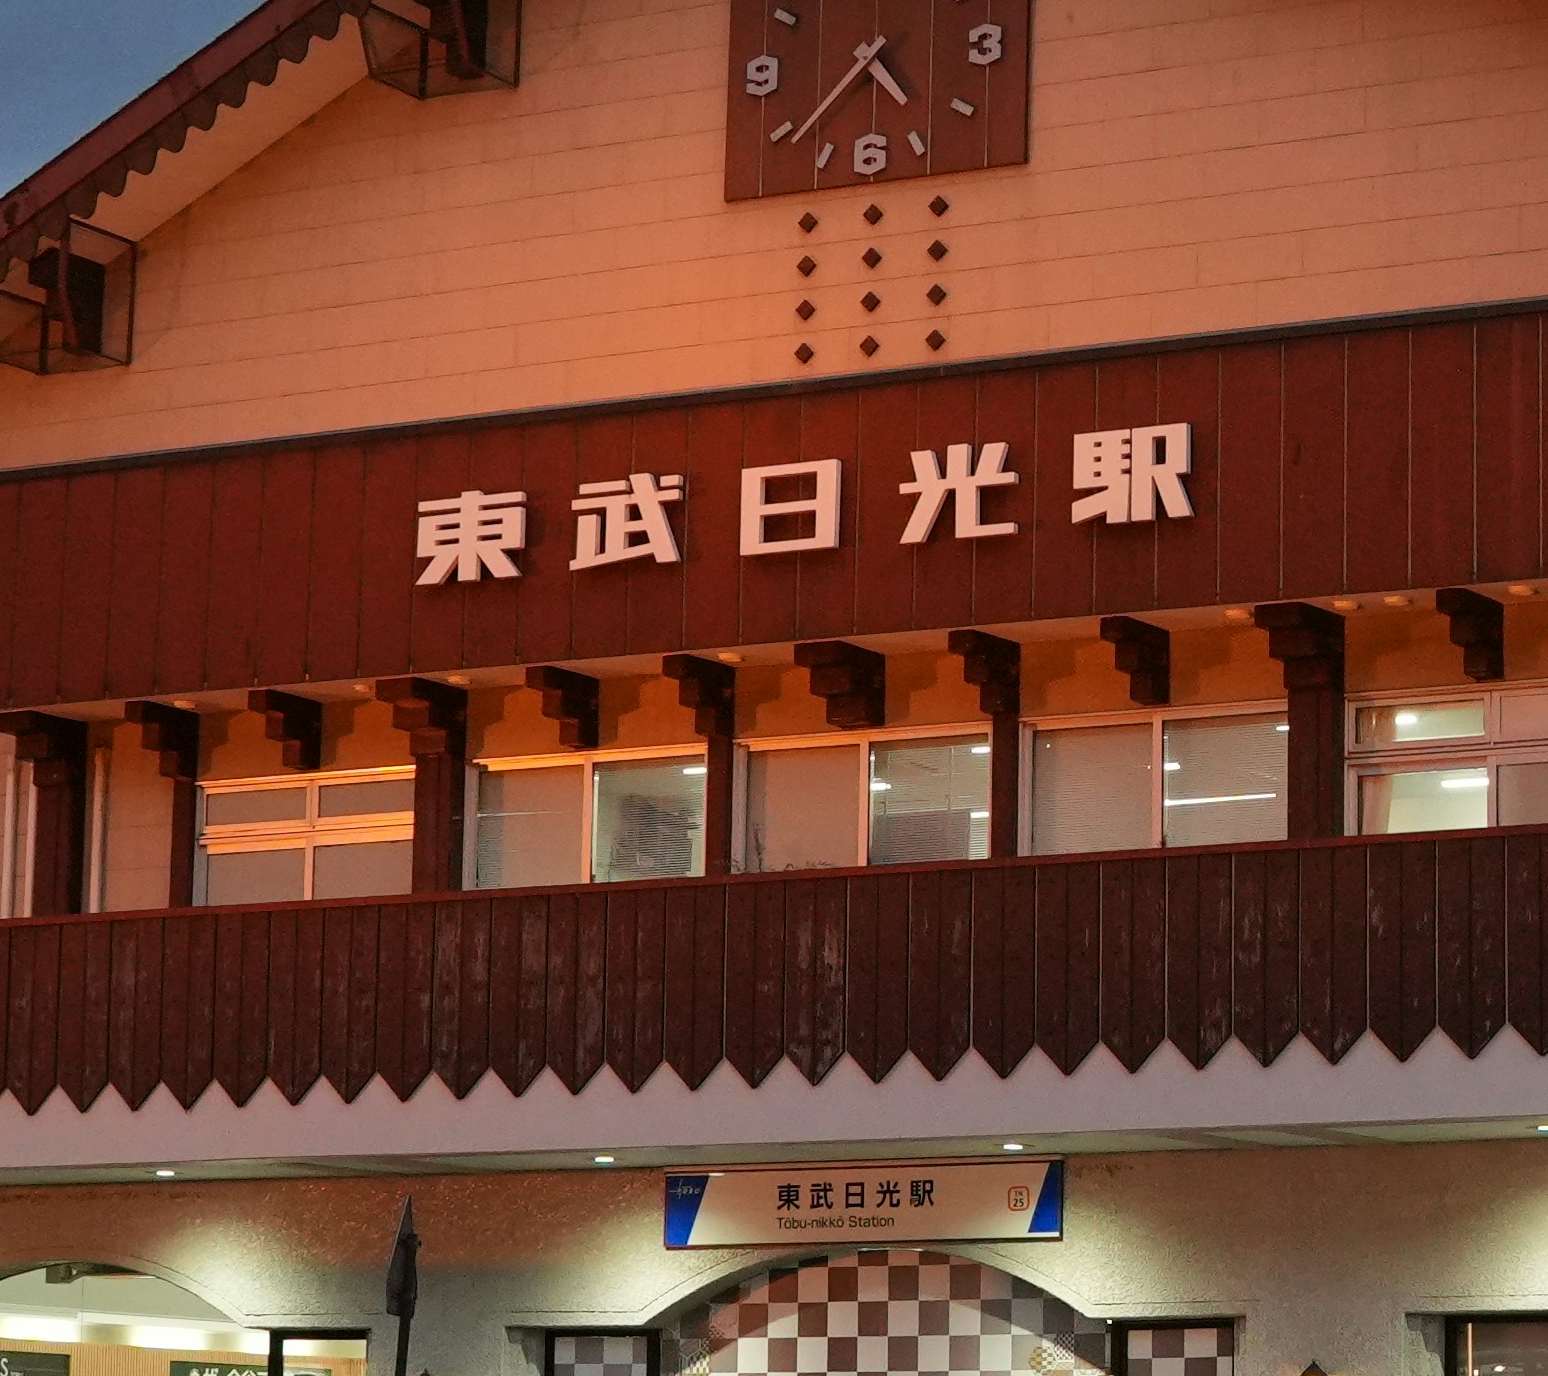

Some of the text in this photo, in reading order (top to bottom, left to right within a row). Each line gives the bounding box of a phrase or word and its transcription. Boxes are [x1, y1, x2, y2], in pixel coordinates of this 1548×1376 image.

[746, 24, 1002, 96] 9 3
[854, 133, 887, 175] 6
[414, 422, 1194, 586] 東武日光駅
[776, 1180, 934, 1211] 東武日光駅
[1013, 1198, 1024, 1208] 25
[849, 1215, 895, 1228] Station
